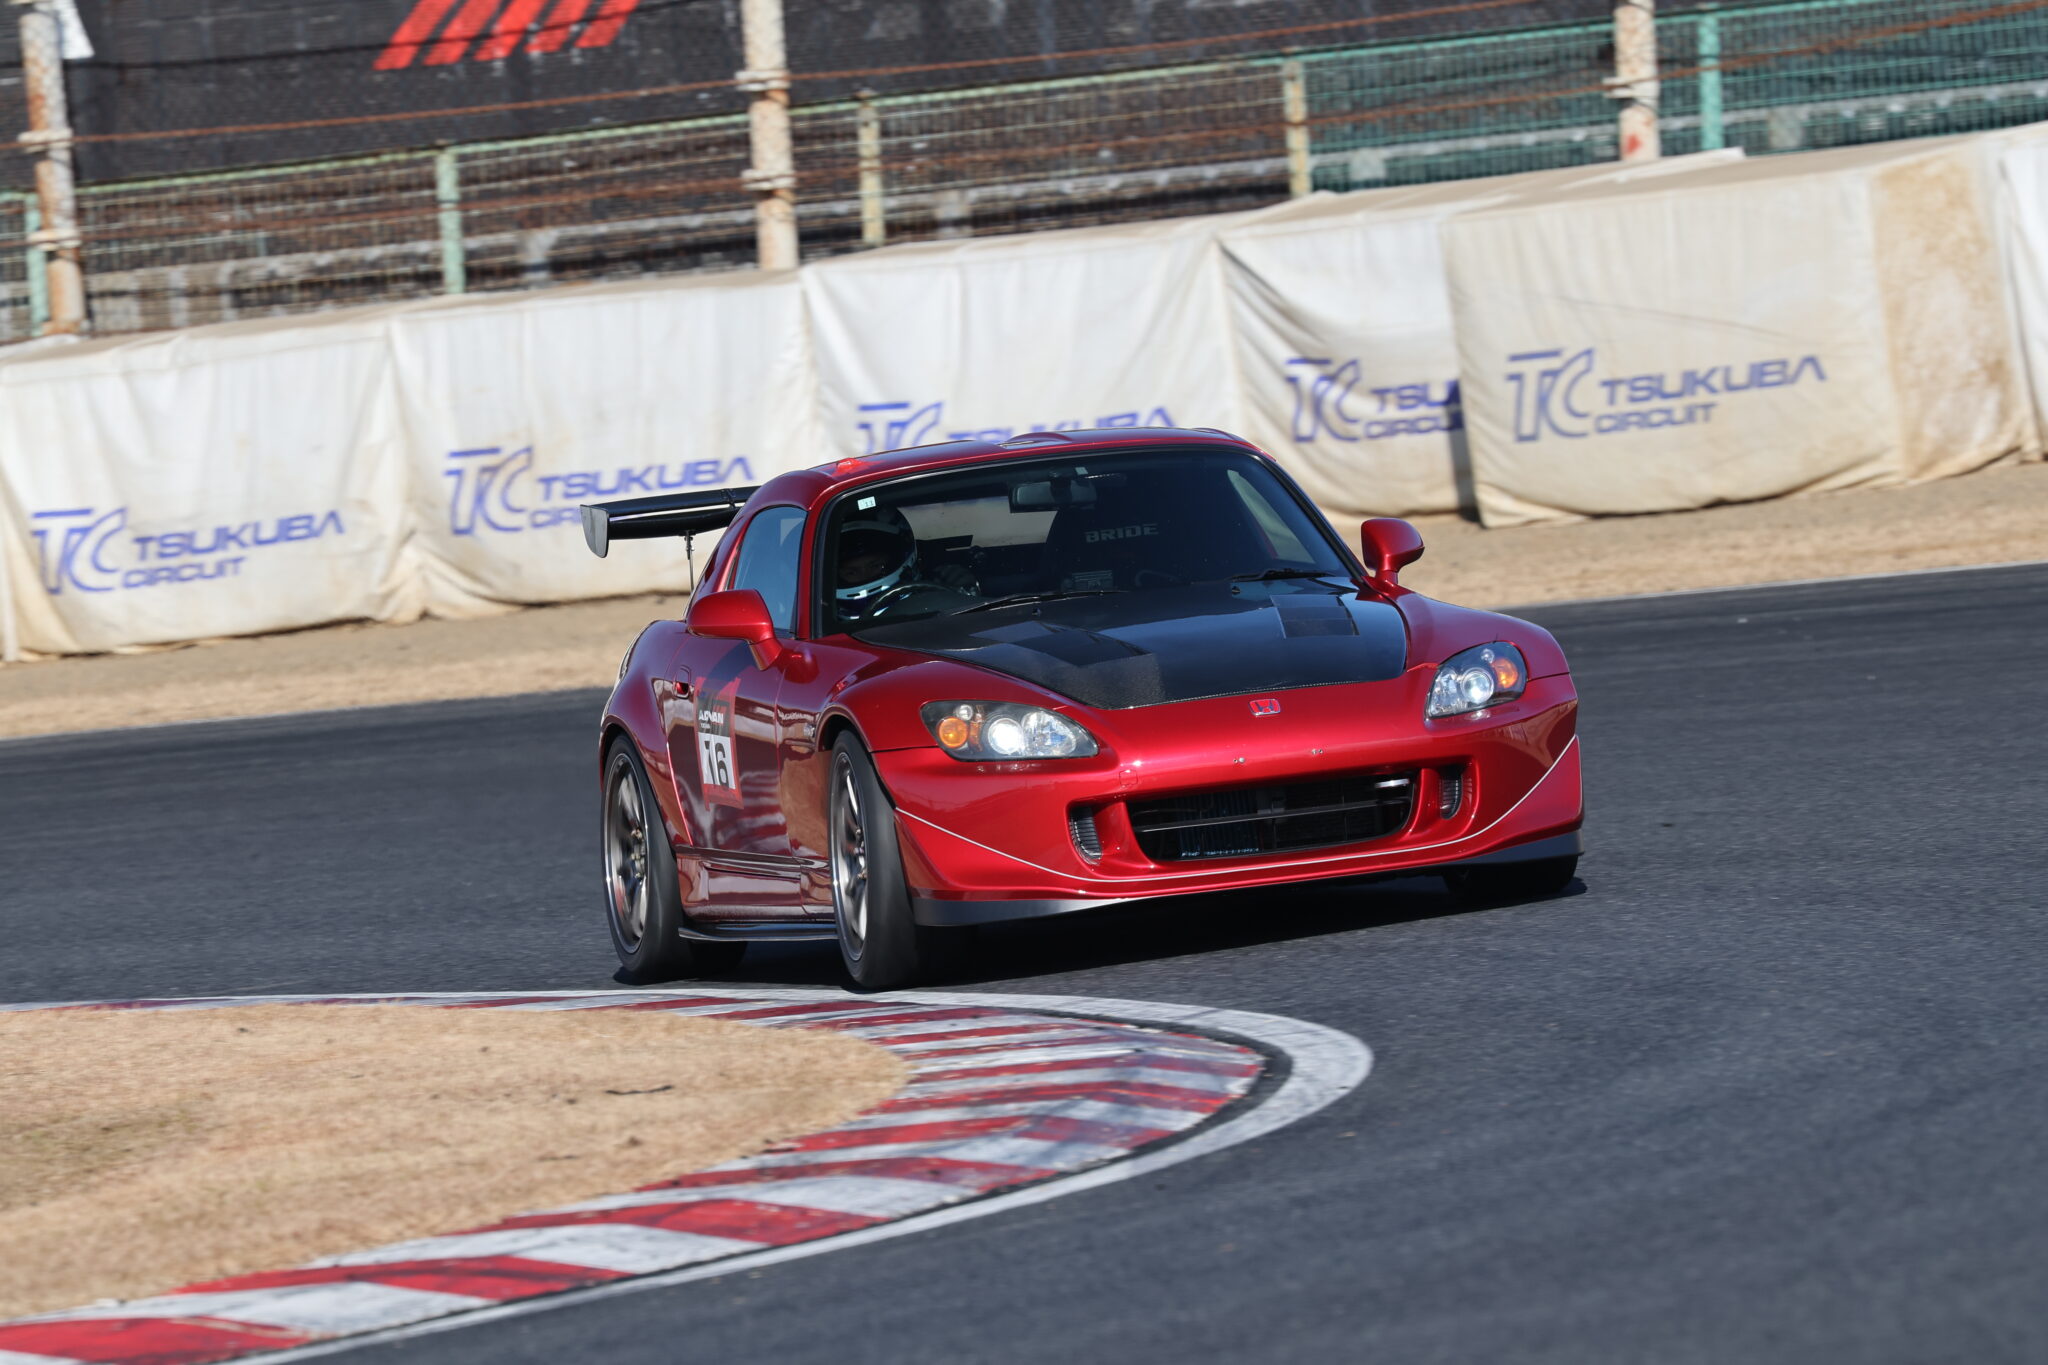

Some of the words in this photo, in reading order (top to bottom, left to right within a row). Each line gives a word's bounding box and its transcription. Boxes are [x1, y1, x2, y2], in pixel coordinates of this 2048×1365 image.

[1505, 348, 1594, 443] TC
[1600, 356, 1827, 405] TSUKUBA
[1594, 403, 1718, 434] CIRCUIT
[444, 445, 534, 535] TC
[538, 456, 755, 501] TSUKUBA
[31, 506, 128, 595] TC
[132, 510, 345, 561] TSUKUBA
[1085, 523, 1159, 543] BRIDE
[122, 556, 247, 589] CIRCUIT
